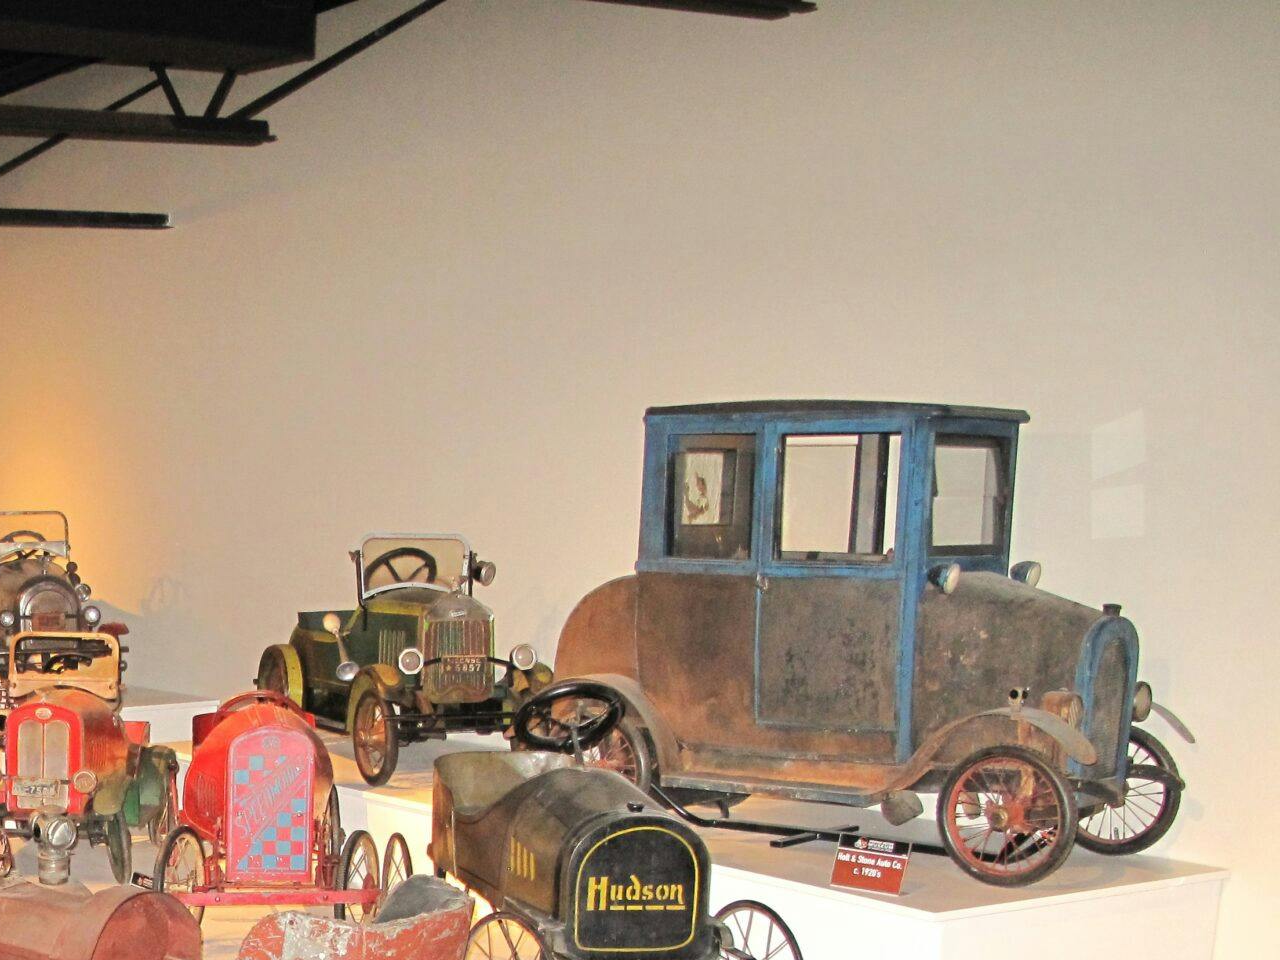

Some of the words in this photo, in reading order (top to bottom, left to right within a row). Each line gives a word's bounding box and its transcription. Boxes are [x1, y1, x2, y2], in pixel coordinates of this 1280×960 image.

[876, 858, 891, 868] Auto
[892, 860, 902, 870] Co.
[586, 874, 686, 911] Hudson
